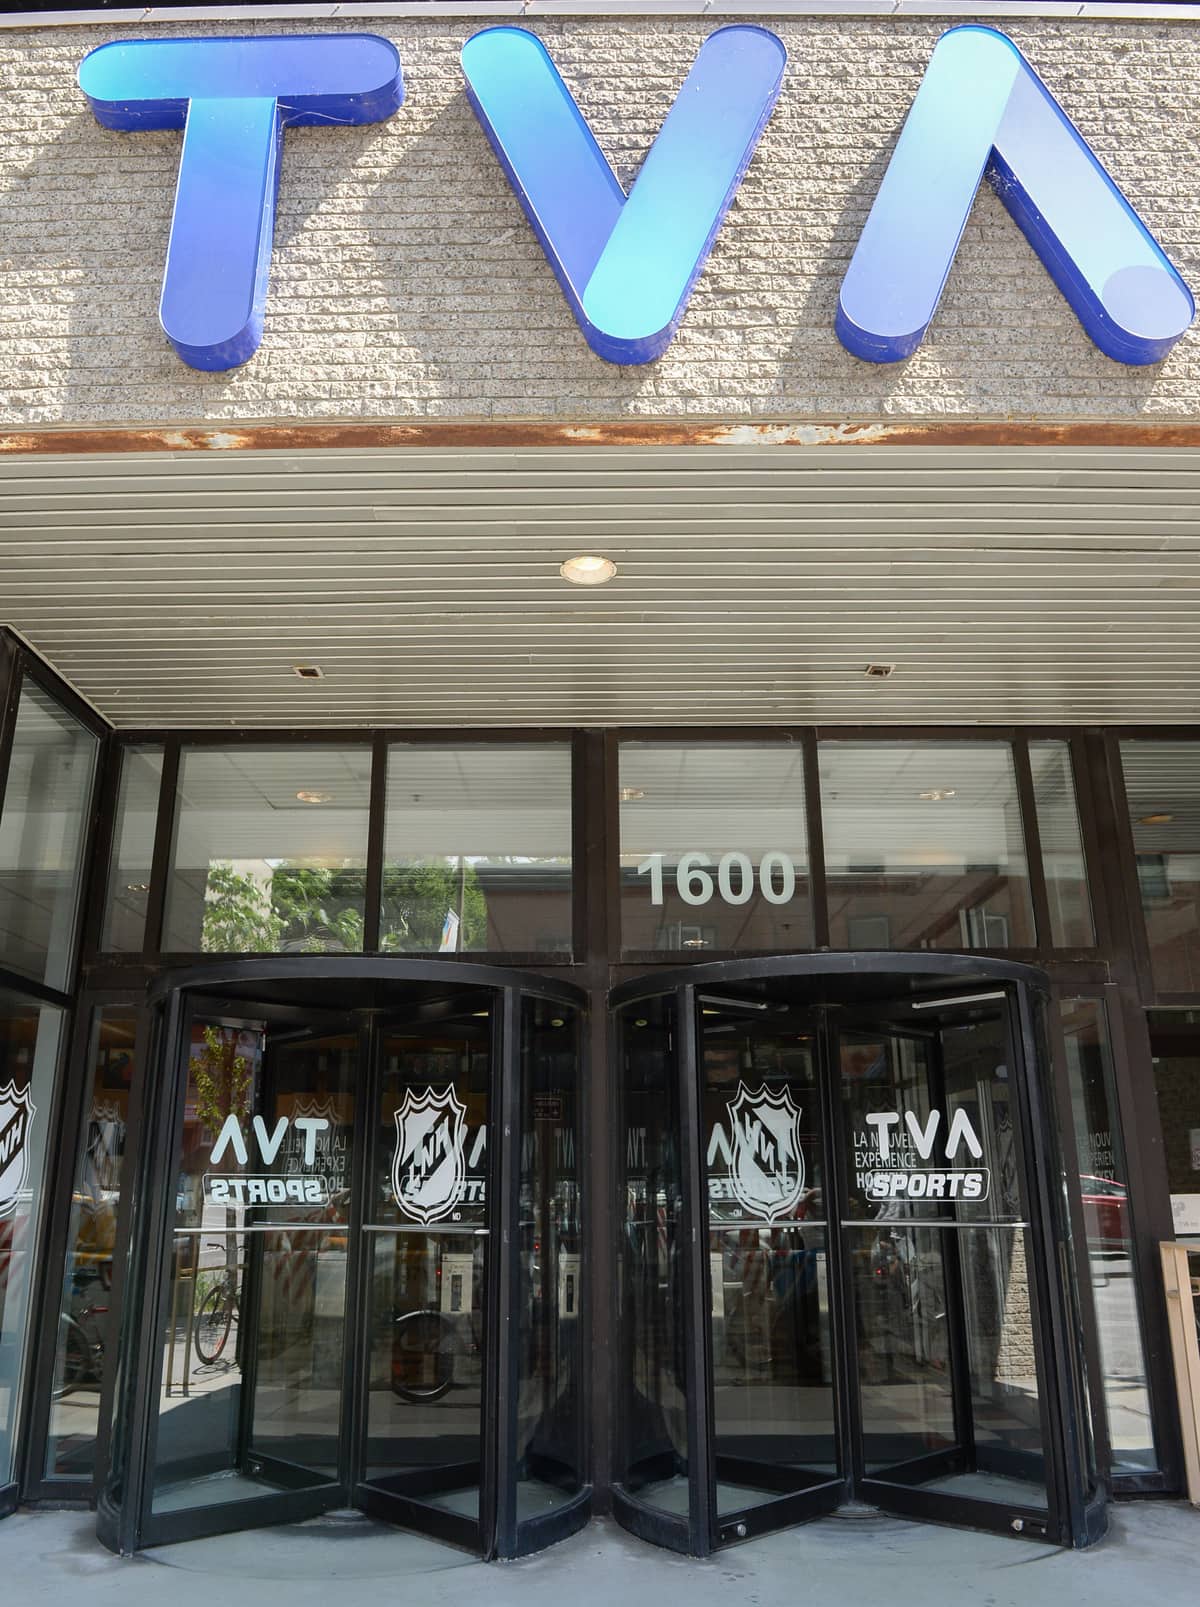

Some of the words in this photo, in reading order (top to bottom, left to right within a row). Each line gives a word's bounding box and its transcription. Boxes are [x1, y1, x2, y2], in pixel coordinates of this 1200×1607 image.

[77, 26, 1195, 371] TVA
[637, 851, 795, 905] 1600
[853, 1131, 868, 1148] LA
[865, 1108, 983, 1160] TVA
[872, 1173, 983, 1198] SPORTS
